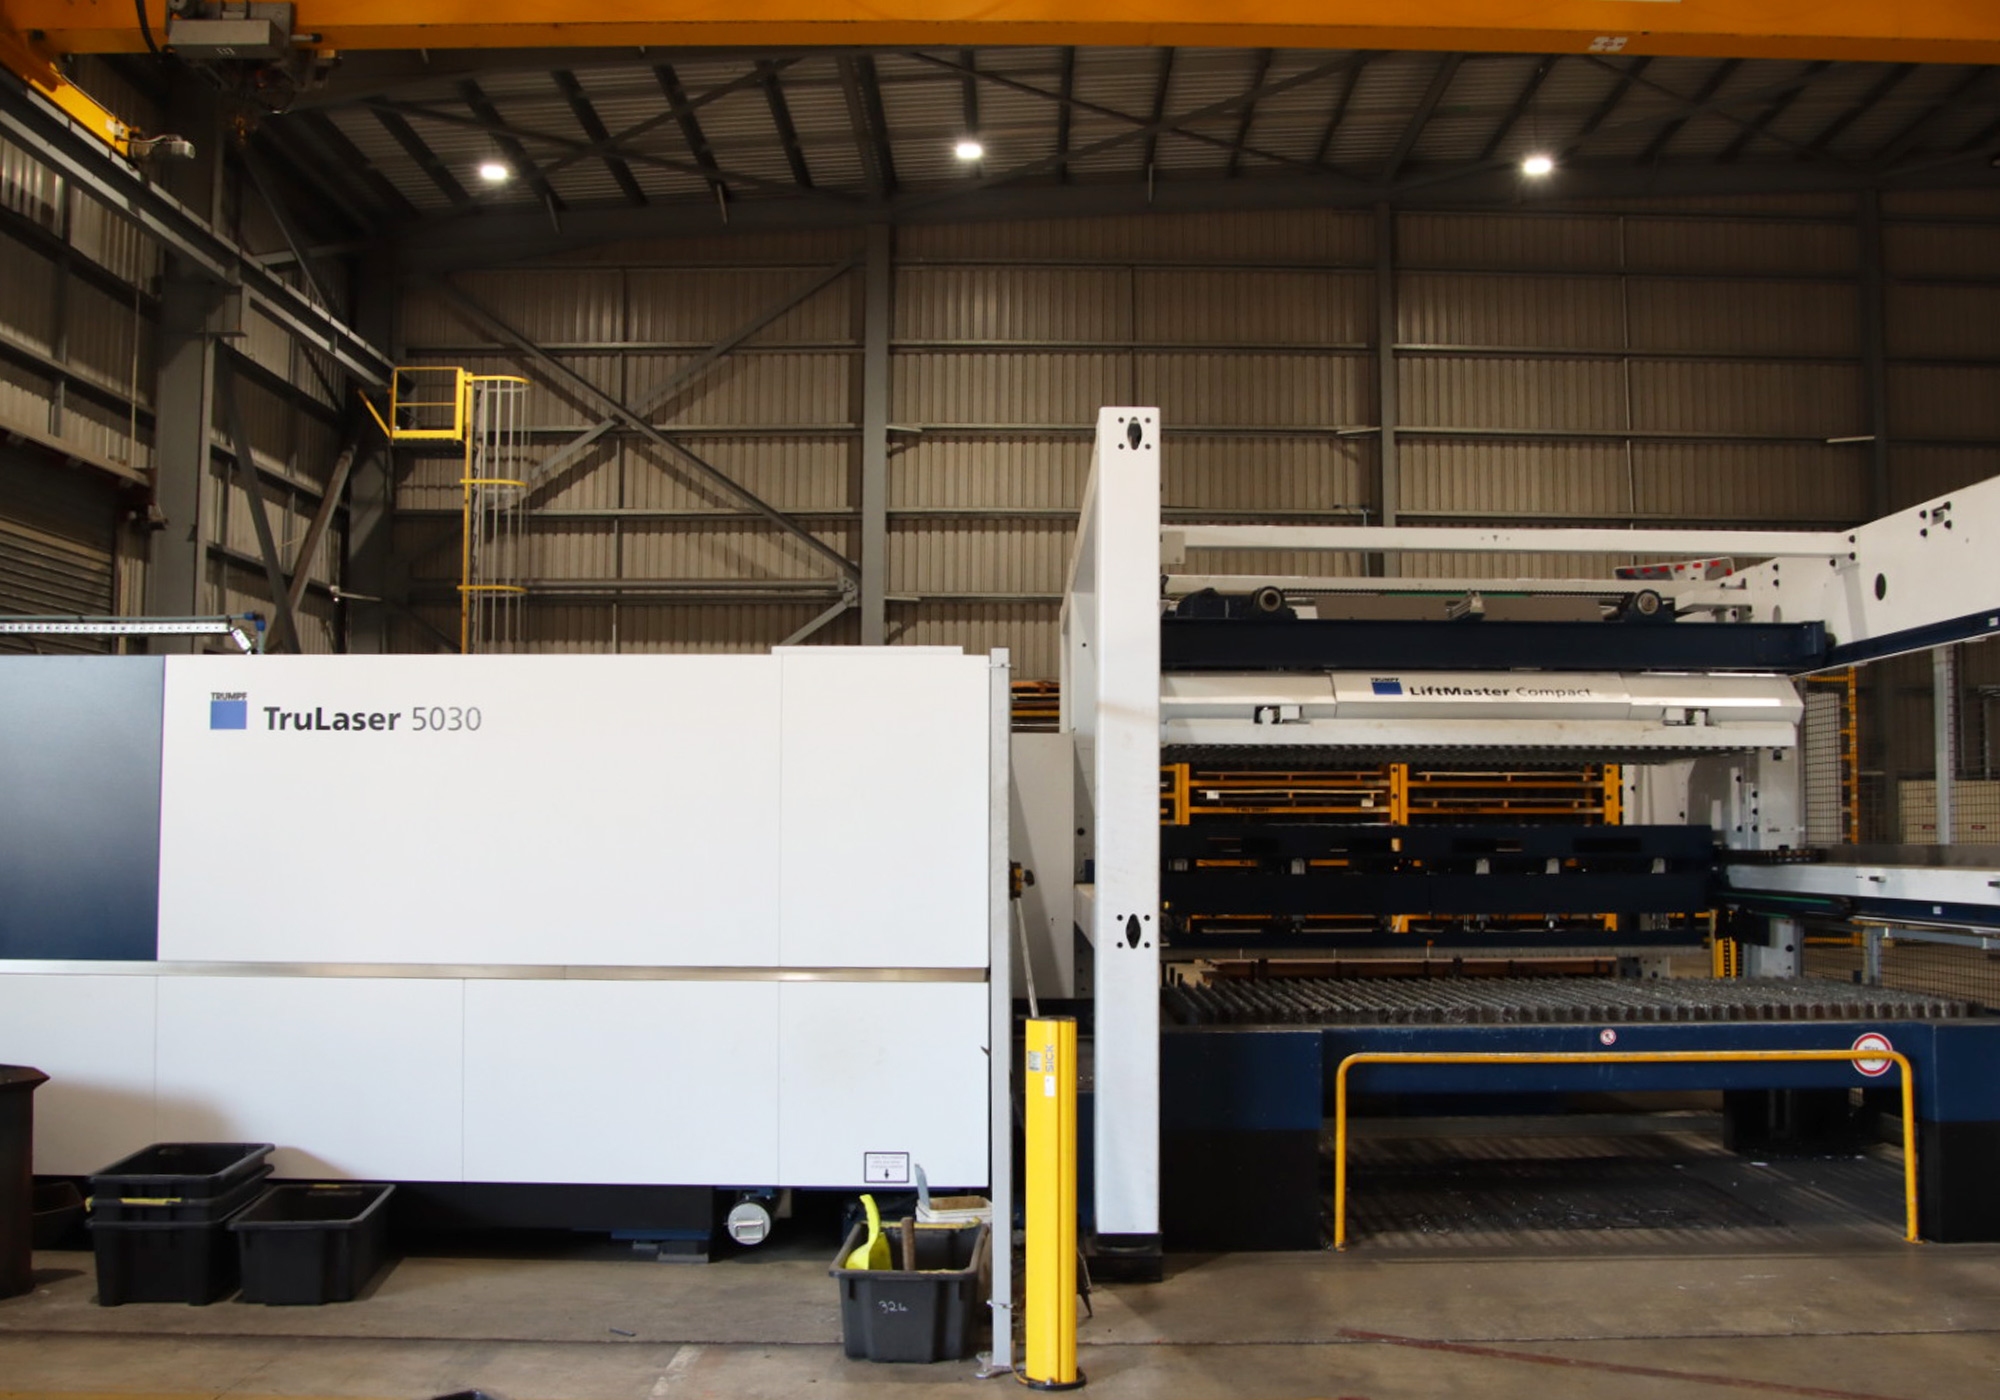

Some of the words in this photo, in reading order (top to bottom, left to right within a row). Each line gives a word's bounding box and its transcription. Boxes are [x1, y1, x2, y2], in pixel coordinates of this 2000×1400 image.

[210, 692, 247, 700] TRUMPF
[1409, 686, 1510, 696] LiftMaster
[1515, 687, 1591, 698] Compact
[263, 706, 402, 731] TruLaser
[412, 706, 482, 731] 5030
[1045, 1045, 1054, 1072] SICK
